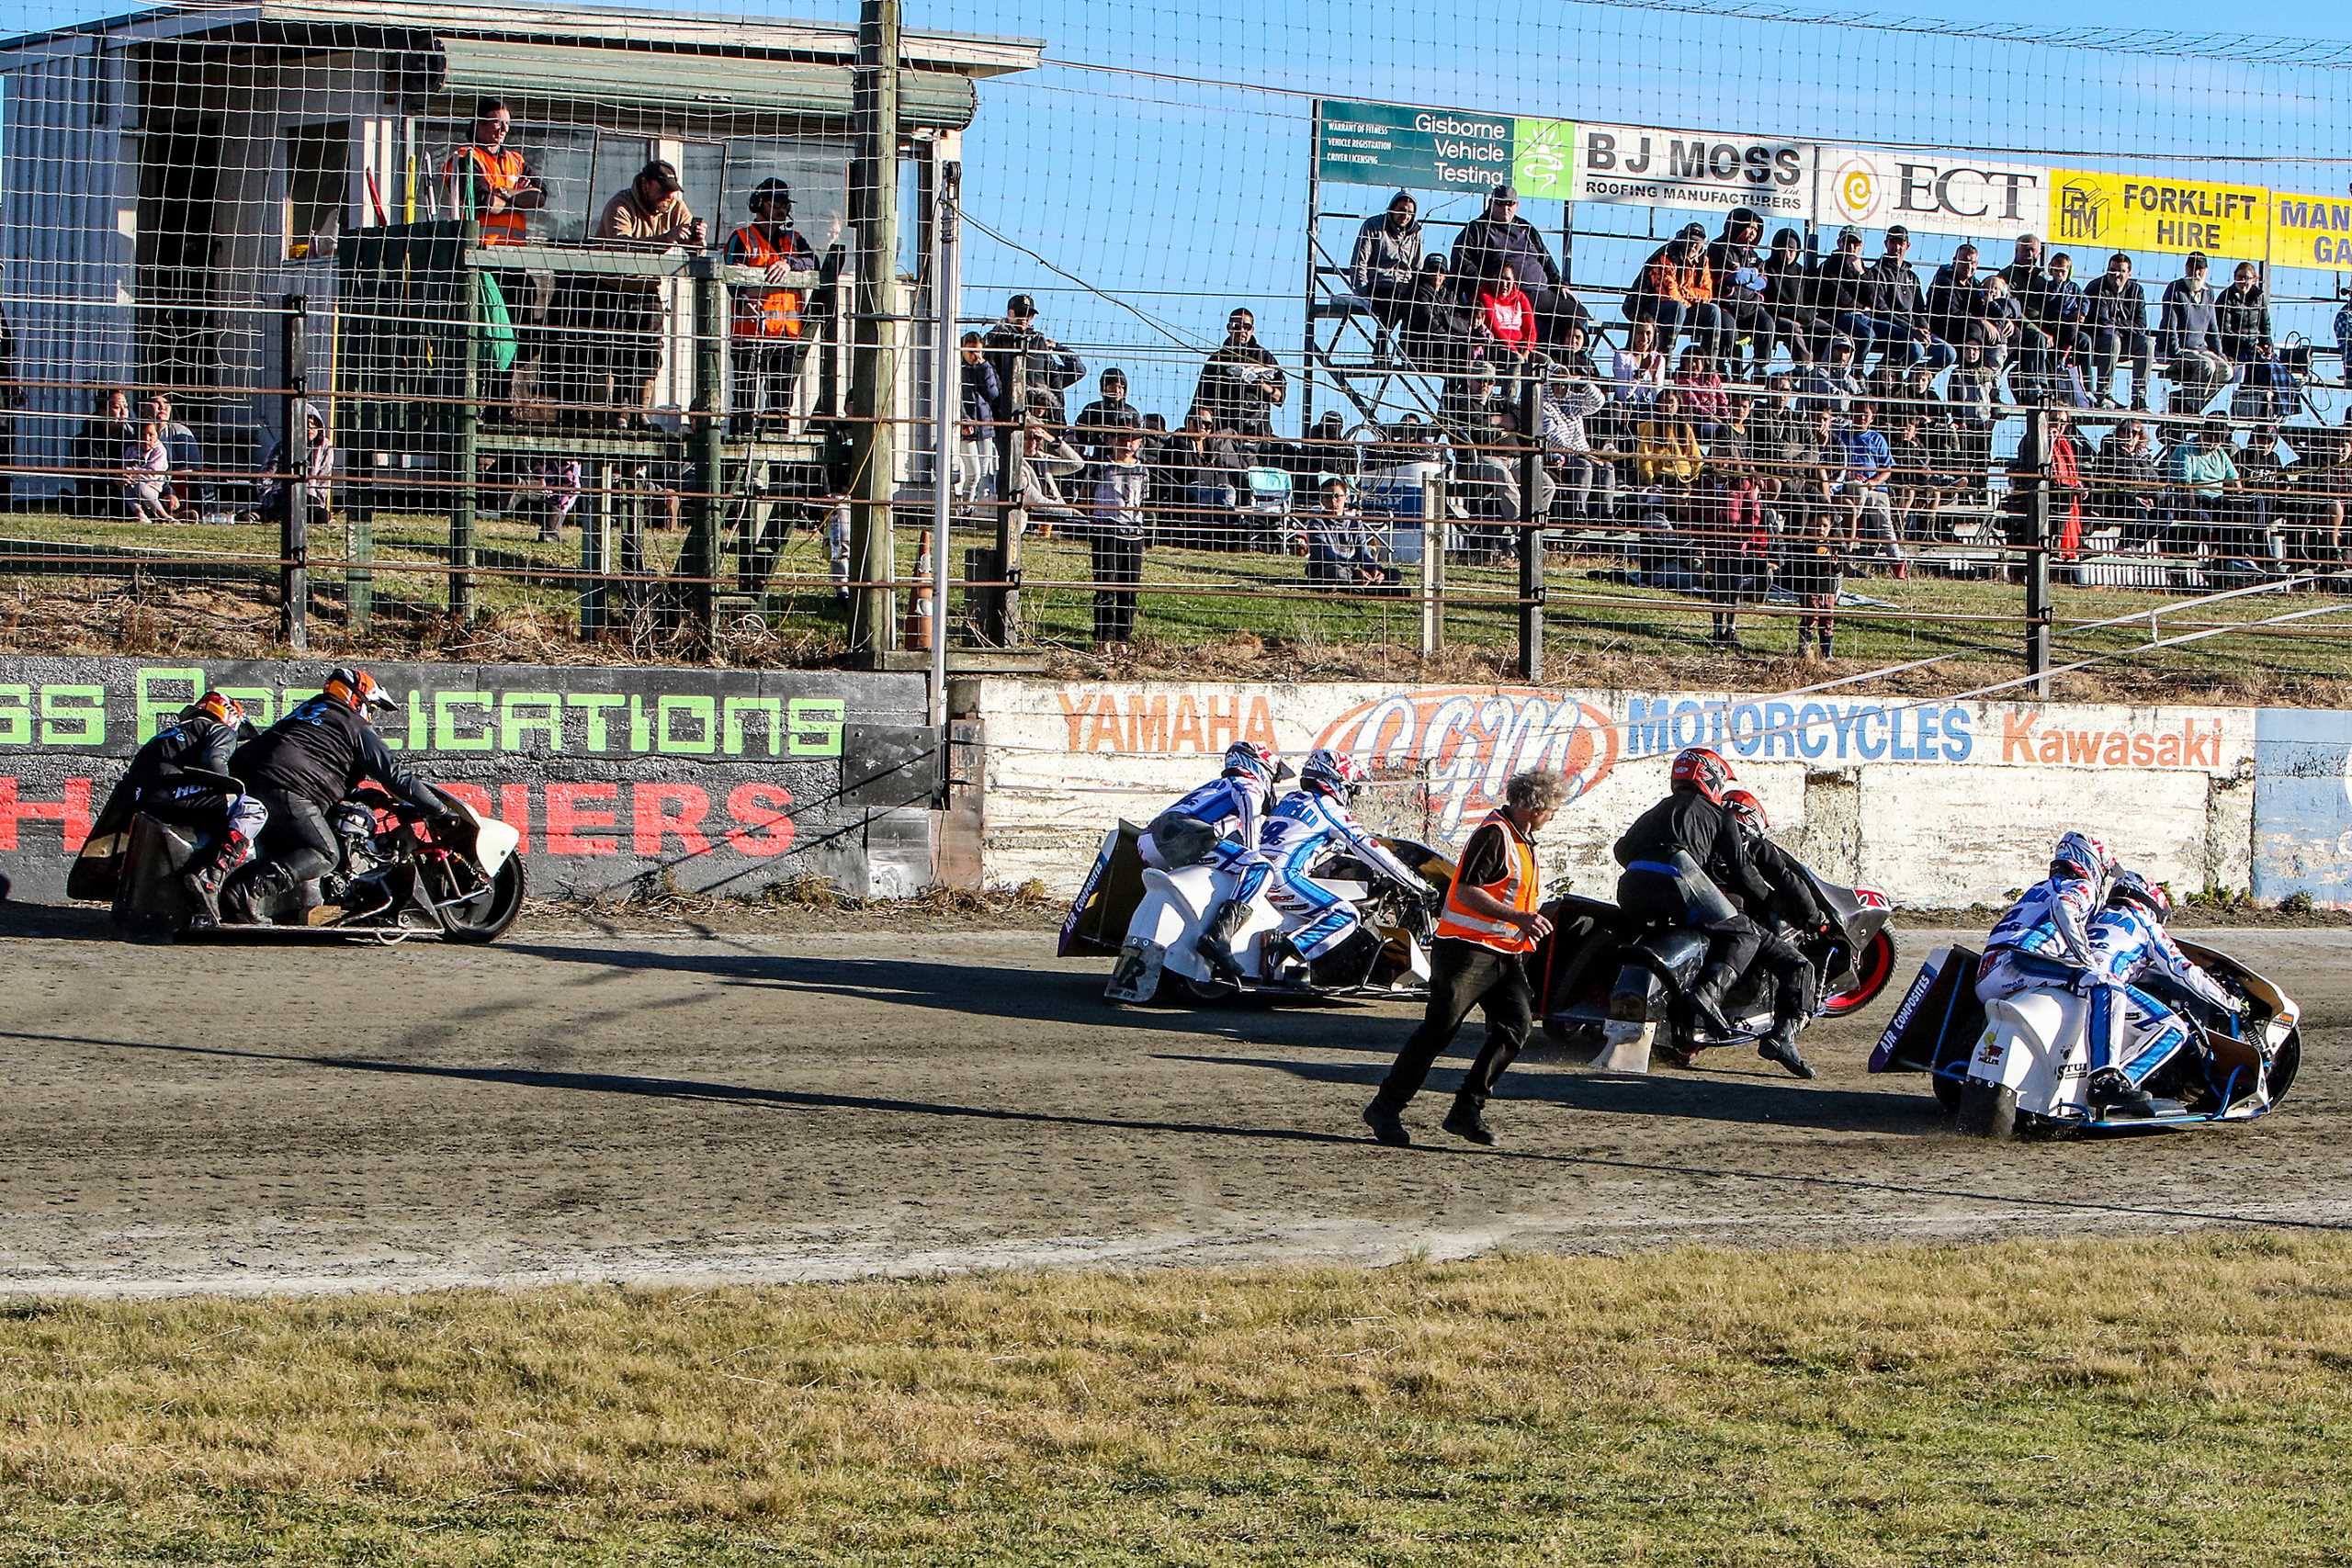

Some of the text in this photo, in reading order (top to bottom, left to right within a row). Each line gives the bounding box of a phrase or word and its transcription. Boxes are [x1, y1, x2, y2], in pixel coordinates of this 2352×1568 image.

[1328, 122, 1388, 135] WARRANT OF FITNESS
[1415, 113, 1505, 139] Gisborne
[1328, 137, 1391, 151] VEHICLE REGISTRATION
[1434, 138, 1505, 163] Vehicle
[1433, 162, 1504, 189] Testing
[1668, 140, 1802, 186] MOSS
[1586, 181, 1802, 209] ROOFING MANUFACTURERS
[1893, 163, 2038, 220] ECT
[2124, 184, 2256, 220] FORKLIFT
[2280, 200, 2351, 231] MAN
[2157, 220, 2221, 250] HIRE
[1057, 693, 1280, 753] YAMAHA
[1627, 698, 1973, 762] MOTORCYCLES
[2002, 711, 2223, 767] Kawasaki
[1065, 861, 1102, 933] AJR COMPOSITES
[1880, 974, 1930, 1054] AJR COMPOSITES
